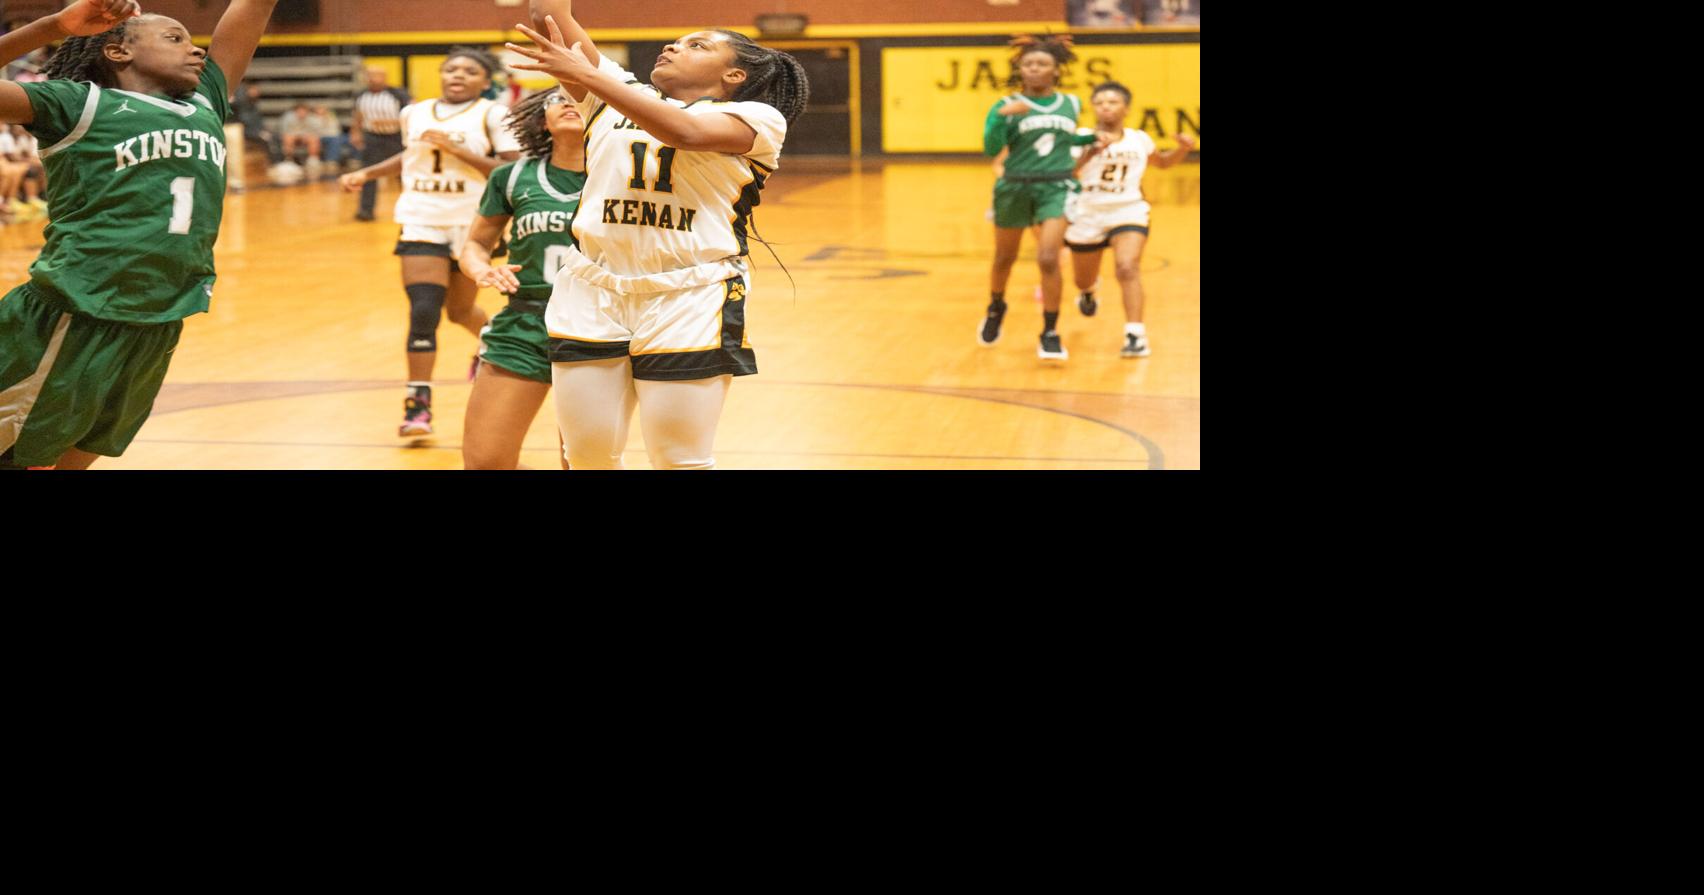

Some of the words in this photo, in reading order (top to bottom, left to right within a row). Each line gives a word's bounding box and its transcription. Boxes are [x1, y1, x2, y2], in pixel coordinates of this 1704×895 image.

[937, 57, 1113, 91] JAES
[431, 148, 443, 175] 1
[629, 140, 677, 194] 11
[1101, 163, 1128, 182] 21
[167, 176, 196, 235] 1
[602, 199, 697, 232] KENAN
